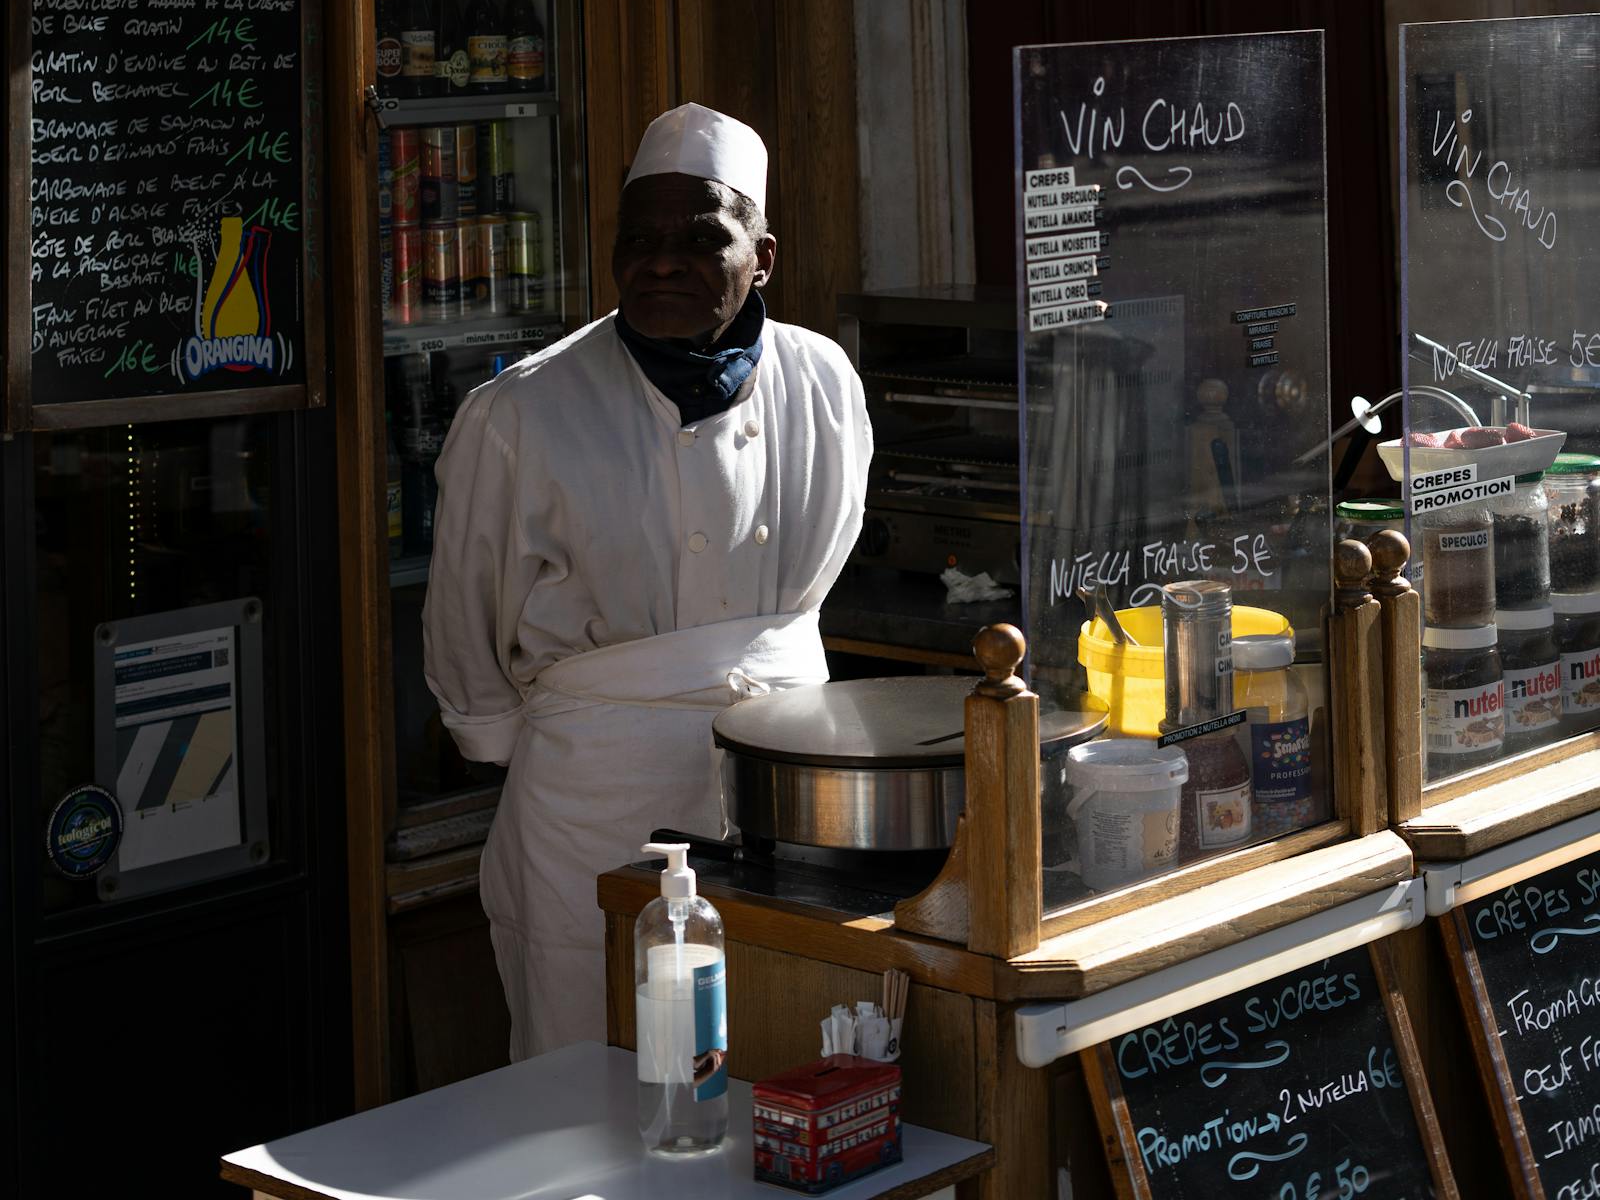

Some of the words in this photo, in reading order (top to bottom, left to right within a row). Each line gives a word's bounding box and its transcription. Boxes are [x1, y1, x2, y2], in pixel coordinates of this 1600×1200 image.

[63, 13, 110, 34] BRIE
[186, 17, 258, 50] 14€
[189, 78, 264, 109] 14€
[1060, 76, 1125, 159] VIN
[1142, 98, 1245, 151] CHAUD
[225, 131, 292, 166] 14€
[1030, 171, 1070, 188] CREPES
[1433, 108, 1482, 178] VIN
[1488, 161, 1557, 249] CHAUD
[241, 197, 300, 232] 14€
[1027, 194, 1058, 209] NUTELLA
[1027, 213, 1058, 230] NUTELLA
[1062, 209, 1093, 225] AMANDE
[74, 234, 95, 256] DE
[1028, 239, 1059, 256] NUTELLA
[1062, 236, 1097, 252] NOISETTE
[1029, 263, 1060, 280] NUTELLA
[1063, 260, 1093, 276] CRUNCH
[1031, 286, 1063, 304] NUTELLA
[1065, 282, 1085, 300] OREO
[33, 302, 77, 330] FAUX
[1033, 310, 1064, 327] NUTELLA
[1067, 304, 1102, 322] SMARTIES
[185, 335, 273, 379] ORANGINA
[1433, 338, 1498, 382] NUTELLA
[1508, 334, 1557, 368] FRAISE
[1570, 329, 1600, 368] 5€
[1413, 469, 1471, 490] CREPES
[1415, 480, 1511, 511] PROMOTION
[1441, 534, 1488, 548] SPECULOS
[1051, 551, 1129, 606] NUTELLA
[1143, 540, 1215, 579] FRAISE
[1231, 534, 1273, 576] 5€
[1163, 728, 1198, 745] PROMOTION
[1476, 885, 1570, 939] CRÊPES
[1118, 1017, 1239, 1079] CRÊPES
[1244, 958, 1361, 1033] SUCRÉES
[1137, 1108, 1258, 1175] PROMOTION
[1280, 1088, 1297, 1124] 2
[1298, 1070, 1369, 1113] NUTELLA
[1368, 1045, 1403, 1089] 6€
